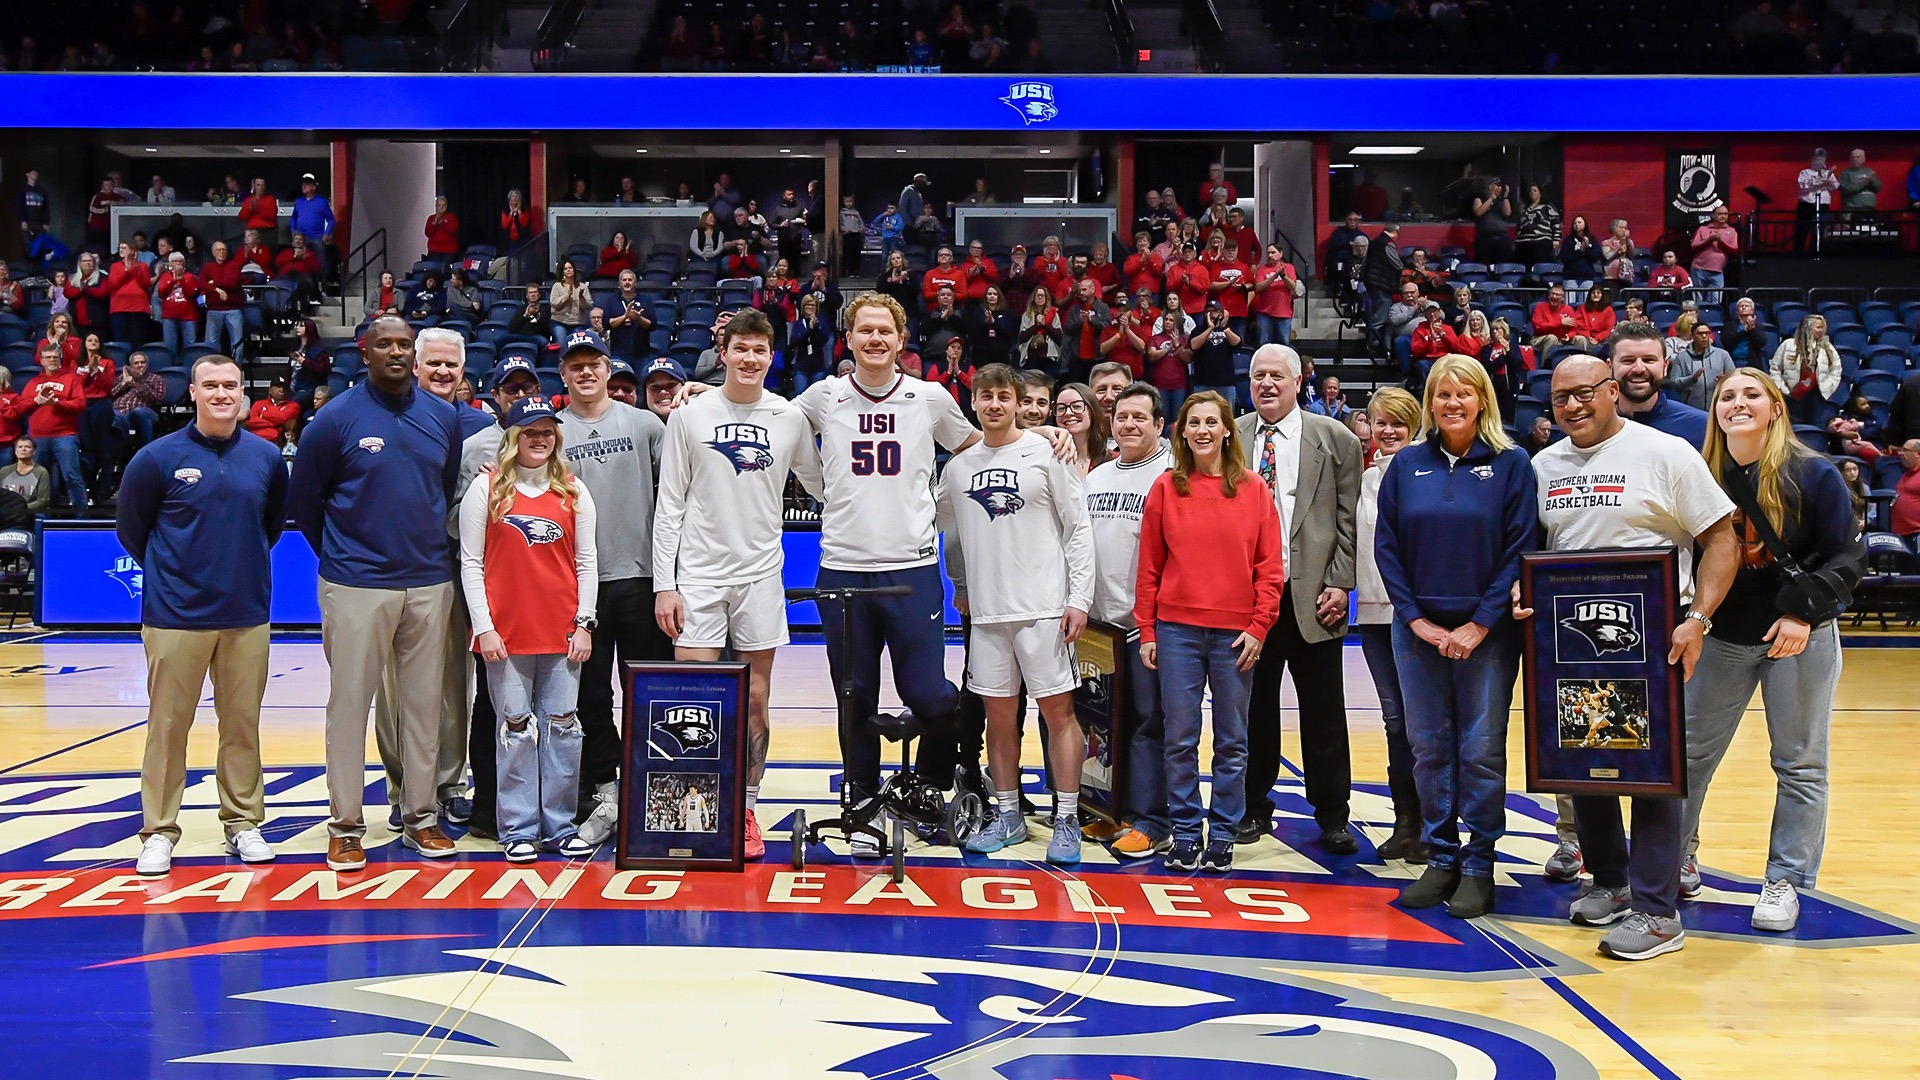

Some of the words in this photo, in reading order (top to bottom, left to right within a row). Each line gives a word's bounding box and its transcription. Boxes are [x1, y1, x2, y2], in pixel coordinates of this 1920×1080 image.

[1012, 84, 1051, 100] USI
[1680, 155, 1697, 176] POW
[1701, 154, 1716, 176] MIA
[568, 336, 593, 348] MILK
[503, 361, 529, 371] MILK
[648, 362, 674, 373] MILK
[523, 403, 551, 413] MILK
[858, 413, 896, 434] USI
[716, 424, 769, 446] USI
[565, 441, 601, 457] SOUTHERN
[602, 436, 632, 449] INDIANA
[851, 440, 902, 477] 50
[973, 470, 1017, 491] USI
[1548, 475, 1588, 490] SOUTHERN
[1590, 474, 1626, 485] INDIANA
[1545, 494, 1622, 512] BASKETBALL
[1578, 603, 1629, 623] USI
[668, 708, 708, 725] USI
[765, 871, 1312, 924] EAGLES
